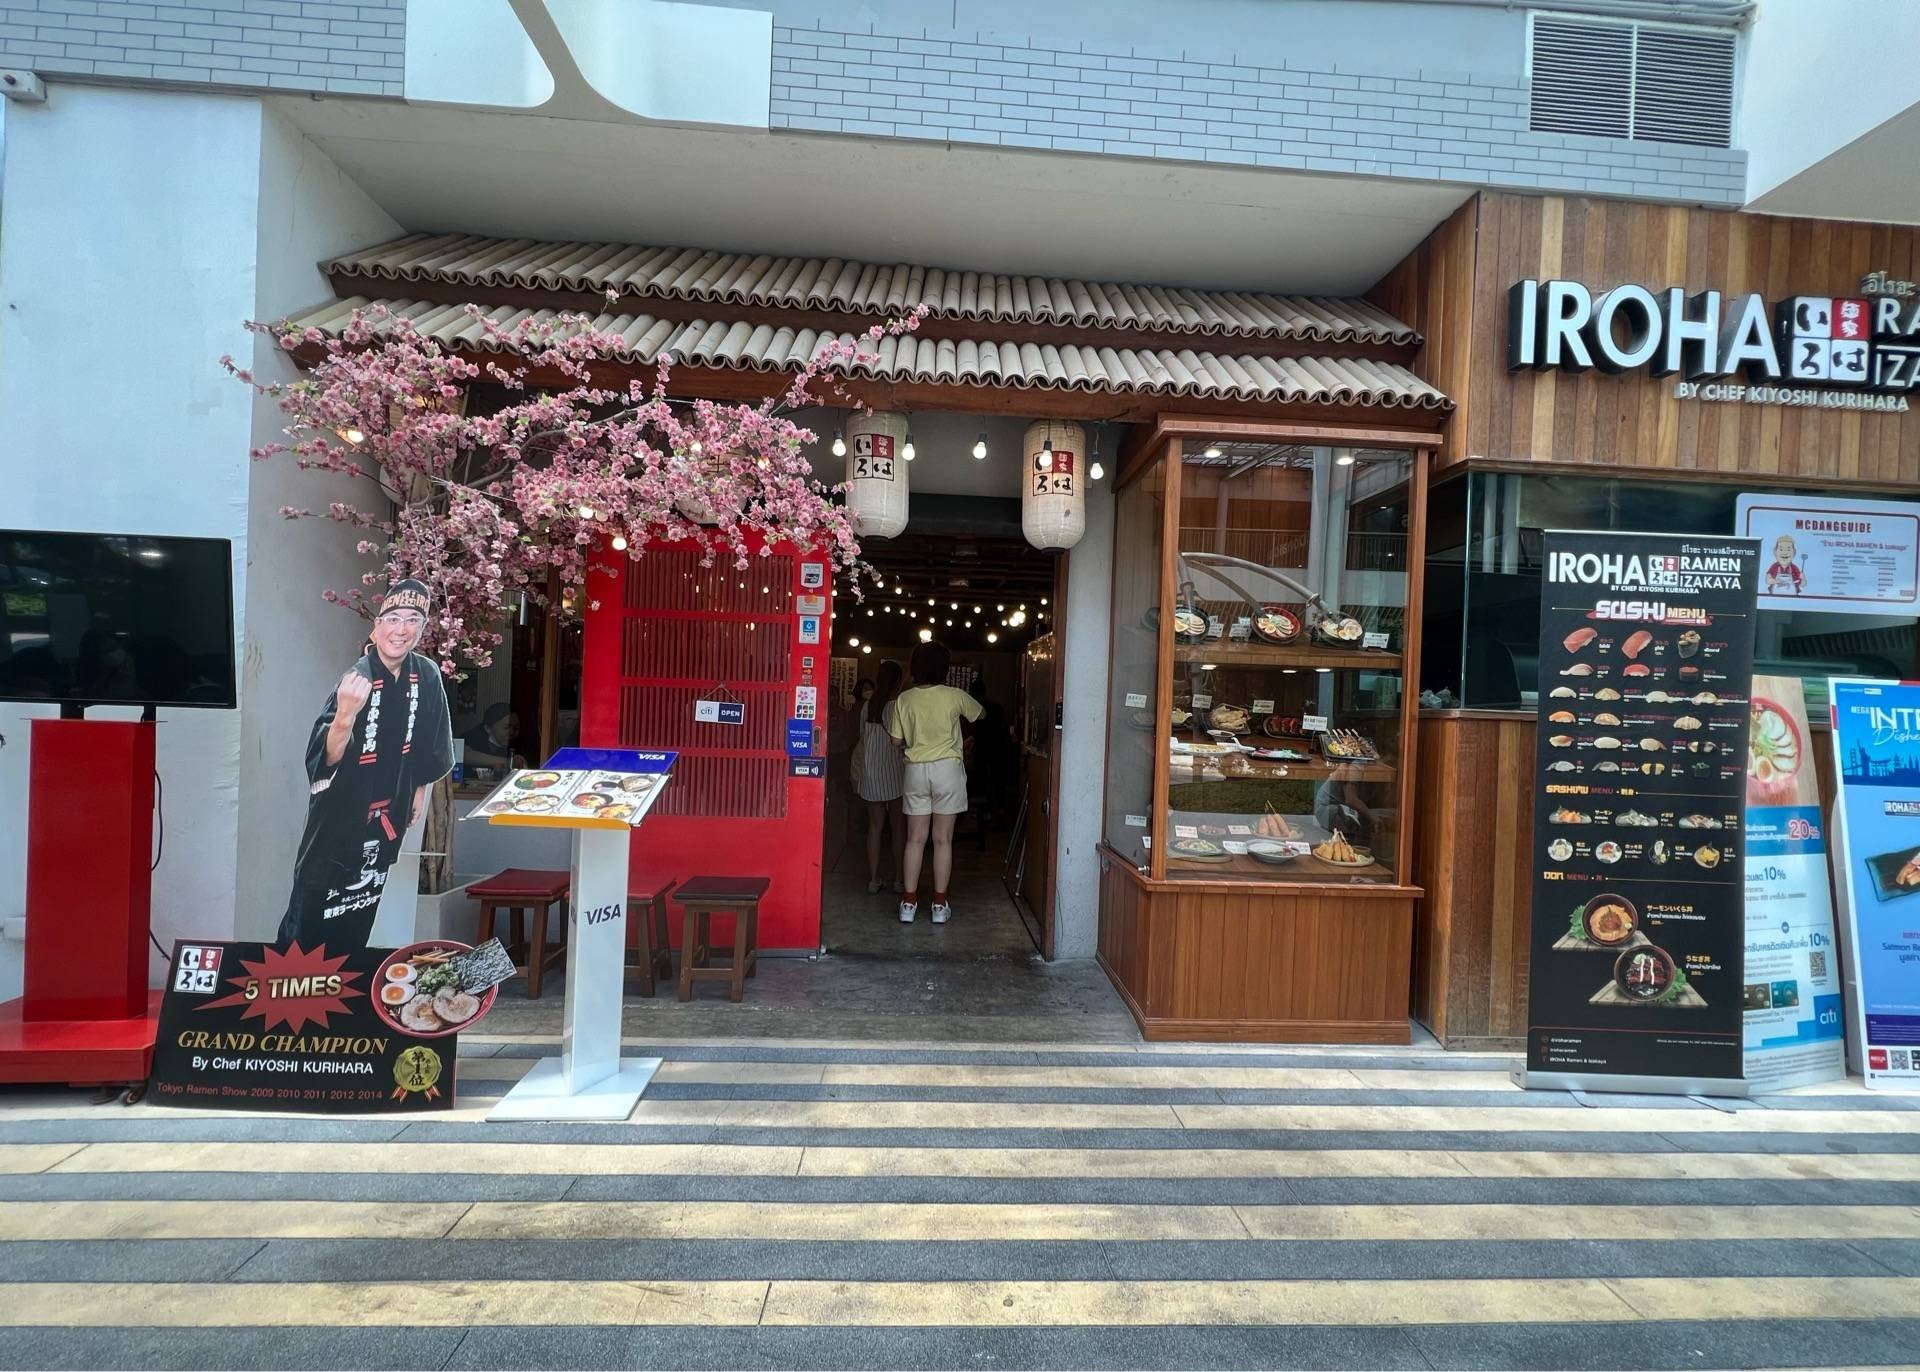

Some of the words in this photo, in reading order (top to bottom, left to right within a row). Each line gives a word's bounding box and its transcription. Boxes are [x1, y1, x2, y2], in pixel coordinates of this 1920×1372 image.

[1517, 279, 1782, 378] IROHA
[1678, 381, 1700, 399] BY
[1705, 384, 1746, 401] CHEF
[1749, 386, 1818, 406] KIYOSHI
[1823, 390, 1911, 412] KURIHARA
[1795, 519, 1872, 534] MCDANGGUIDE
[1549, 551, 1647, 586] IROHA
[1681, 556, 1741, 572] RAMEN
[1610, 584, 1620, 592] BY
[1680, 575, 1742, 590] IZAKAYA
[1595, 600, 1666, 621] SUSHI
[1667, 607, 1706, 619] MENU
[700, 706, 713, 716] citi
[720, 709, 741, 718] OPEN
[791, 740, 809, 749] VISA
[637, 752, 667, 761] VISA
[1591, 787, 1614, 795] MENU
[1788, 818, 1820, 841] 20%
[1566, 873, 1589, 881] MENU
[1763, 866, 1787, 881] 10%
[584, 903, 622, 926] VISA
[1808, 932, 1830, 948] 10%
[244, 979, 260, 1001] 5
[267, 974, 343, 1000] TIMES
[1819, 1011, 1838, 1025] citi
[177, 1029, 256, 1052] GRAND
[260, 1033, 390, 1056] CHAMPION
[191, 1055, 209, 1071] By
[212, 1057, 242, 1071] Chef
[244, 1060, 298, 1073] KIYOSHI
[302, 1061, 374, 1075] KURIHARA
[156, 1081, 184, 1096] Tokyo
[186, 1083, 219, 1096] Ramen
[221, 1085, 249, 1098] Show
[251, 1087, 275, 1099] 2009
[276, 1088, 301, 1099] 2010
[303, 1088, 328, 1100] 2011
[330, 1089, 355, 1100] 2012
[357, 1089, 383, 1101] 2014
